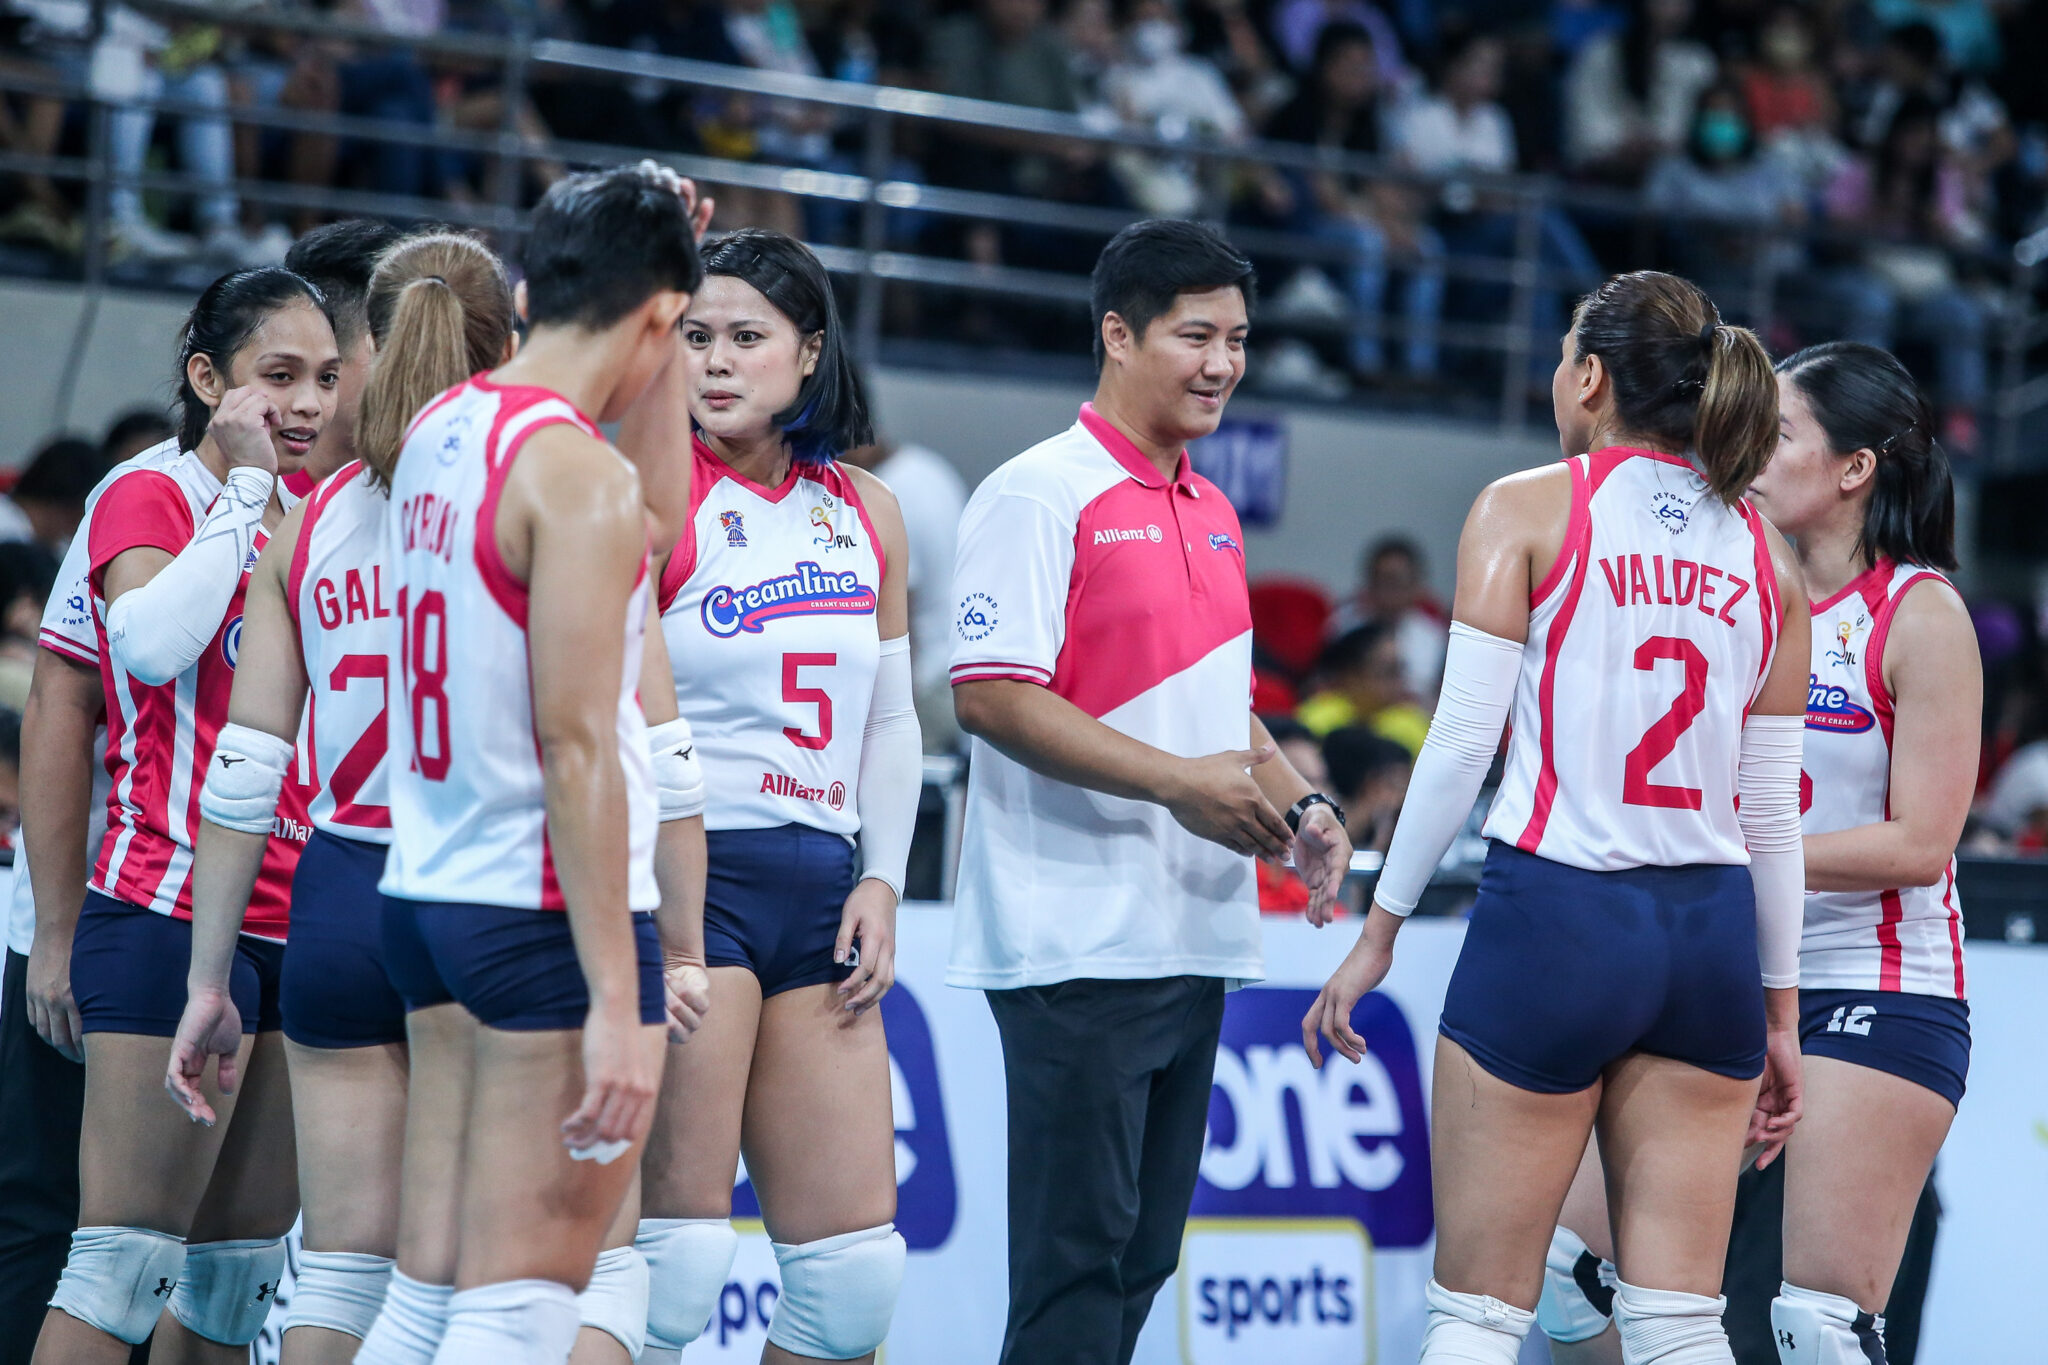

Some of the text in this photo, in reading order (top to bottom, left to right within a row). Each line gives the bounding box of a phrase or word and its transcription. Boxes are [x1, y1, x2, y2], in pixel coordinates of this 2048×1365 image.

[1653, 492, 1691, 506] BEYOND
[836, 534, 857, 549] PVL
[1094, 528, 1147, 545] Allianz
[705, 565, 857, 635] Creamline
[960, 592, 998, 609] BEYOND
[1599, 554, 1750, 627] VALDEZ
[397, 584, 452, 783] 18
[782, 652, 837, 750] 5
[1623, 635, 1709, 811] 2
[1814, 715, 1827, 723] ICE
[1828, 718, 1855, 726] CREAM
[760, 772, 826, 804] Allianz
[1826, 1005, 1878, 1037] 12
[1204, 1041, 1404, 1191] one
[1200, 1263, 1356, 1341] sports
